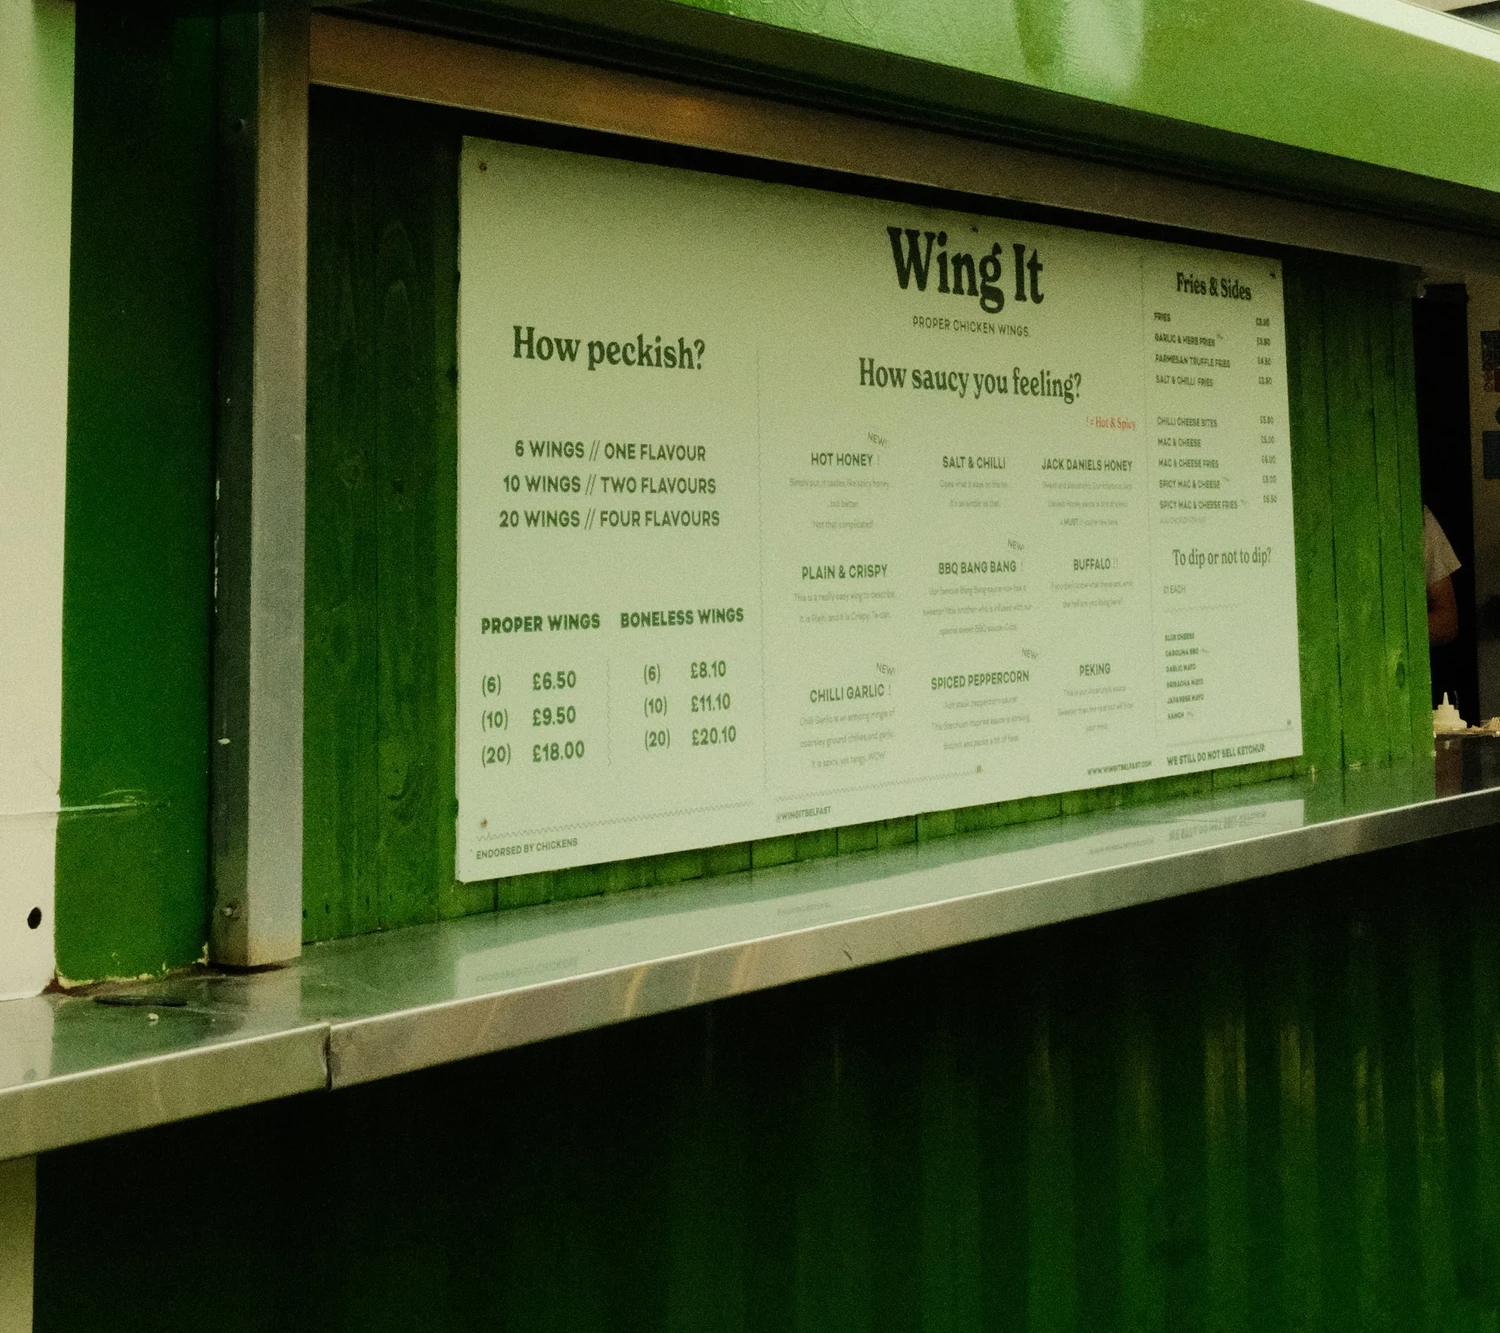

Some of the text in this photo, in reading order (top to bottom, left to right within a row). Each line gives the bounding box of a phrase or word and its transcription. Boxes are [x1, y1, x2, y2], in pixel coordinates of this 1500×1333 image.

[886, 226, 1045, 314] Wing It
[1176, 272, 1252, 301] Fries & Sides
[912, 316, 1029, 337] PROPER CHICKEN WINGS
[1154, 312, 1171, 323] FRIES
[512, 325, 706, 371] How peckish?
[1154, 332, 1176, 344] GARLIC
[1199, 337, 1216, 347] FRIES
[1155, 353, 1188, 365] PARMESAN
[1189, 356, 1214, 367] TRUFFLE
[1215, 358, 1231, 369] FRIES
[858, 357, 1082, 405] How saucy you feeling?
[1156, 374, 1171, 385] SALT
[1176, 375, 1195, 386] CHILLI
[1197, 377, 1214, 387] FRIES
[1095, 416, 1109, 429] Hot
[1109, 417, 1116, 429] &
[1117, 417, 1137, 432] Spicy
[1156, 416, 1176, 426] CHILLI
[1177, 417, 1200, 427] CHEESE
[515, 440, 525, 458] 6
[528, 440, 585, 458] WINGS
[604, 443, 636, 460] ONE
[640, 444, 706, 461] FLAVOUR
[1157, 437, 1171, 447] MAC
[1178, 438, 1201, 448] CHEESE
[811, 452, 874, 467] HOT HONEY
[942, 455, 1006, 470] SALT & CHILLI
[1041, 457, 1133, 472] JACK DANIELS HONEY
[1158, 458, 1172, 468] MAC
[1178, 459, 1202, 468] CHEESE
[1203, 459, 1219, 469] FRIES
[503, 475, 520, 492] 10
[524, 475, 581, 493] WINGS
[600, 476, 637, 494] TWO
[641, 477, 717, 495] FLAVOURS
[1159, 479, 1176, 489] SPICY
[1177, 479, 1191, 489] MAC
[1197, 480, 1220, 489] CHEESE
[1159, 500, 1177, 510] SPICY
[1178, 500, 1192, 510] MAC
[1198, 500, 1221, 510] CHEESE
[1222, 500, 1238, 510] FRIES
[499, 510, 519, 528] 20
[523, 510, 580, 528] WINGS
[600, 510, 641, 527] FOUR
[645, 510, 720, 527] FLAVOURS
[938, 559, 1017, 576] BBQ BANG BANG
[1073, 557, 1111, 572] BUFFALO
[1172, 546, 1272, 569] To dip or not to dip?
[802, 564, 888, 580] PLAIN & CRISPY
[481, 613, 600, 635] PROPER WINGS
[620, 607, 744, 629] BONELESS WINGS
[643, 663, 661, 685] (6)
[690, 660, 727, 679] £8.10
[1079, 662, 1111, 677] PEKING
[482, 674, 501, 697] (6)
[532, 670, 577, 691] £6.50
[931, 669, 1030, 691] SPICED PEPPERCORN
[691, 693, 731, 713] £11.10
[810, 683, 885, 704] CHILLI GARLIC
[532, 706, 577, 727] £9.50
[644, 696, 667, 717] (10)
[482, 709, 508, 732] (10)
[644, 728, 670, 751] (20)
[691, 725, 736, 746] £20.10
[481, 743, 511, 767] (20)
[532, 740, 585, 763] £18.00
[1166, 755, 1179, 767] WE
[1179, 753, 1195, 765] STILL
[1197, 751, 1206, 762] DO
[1207, 749, 1220, 761] NOT
[1221, 748, 1236, 759] SELL
[476, 838, 578, 861] ENDORSED BY CHICKENS
